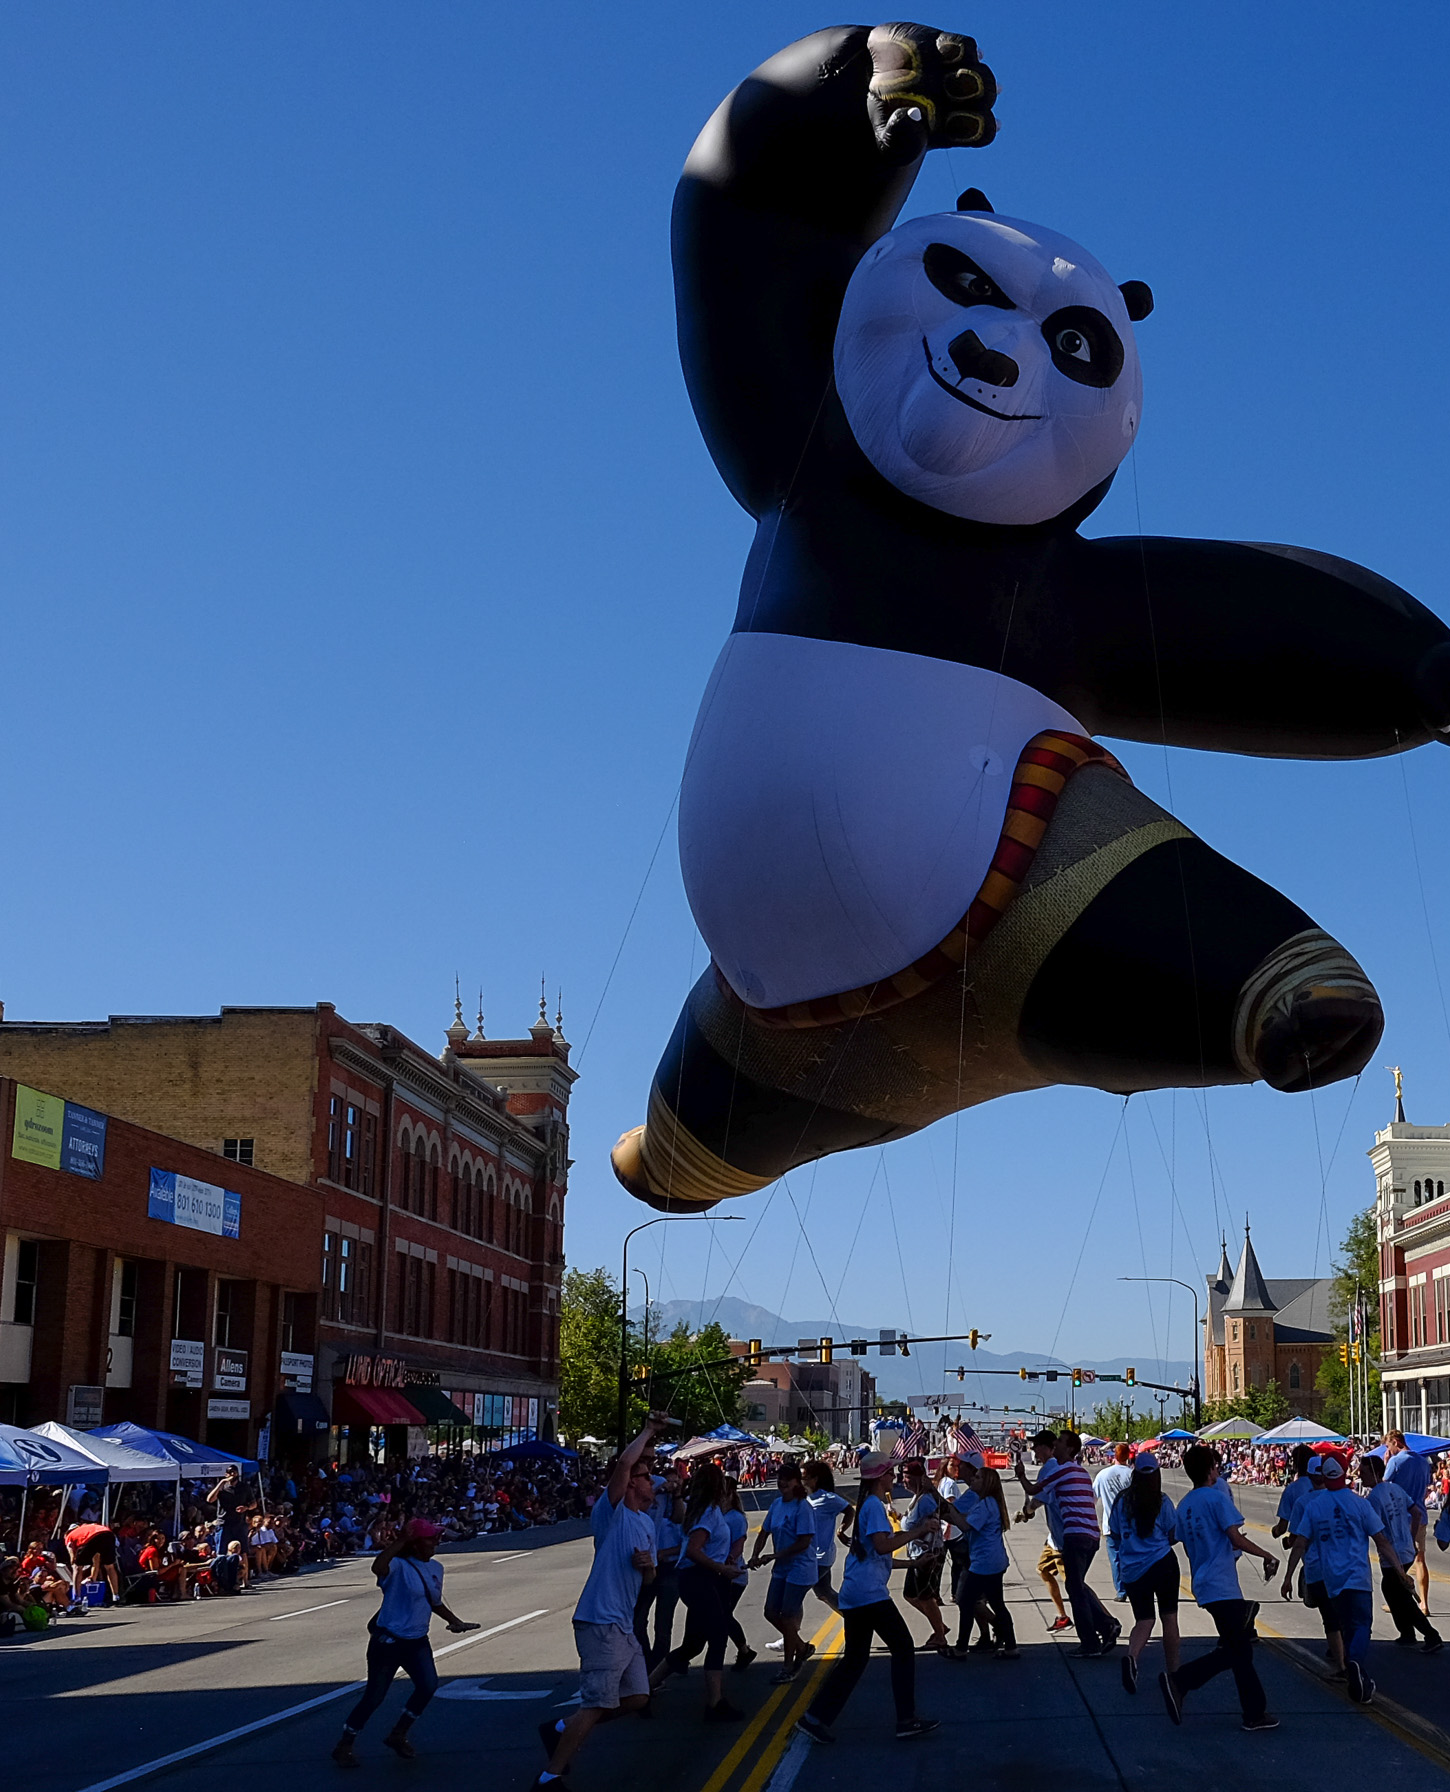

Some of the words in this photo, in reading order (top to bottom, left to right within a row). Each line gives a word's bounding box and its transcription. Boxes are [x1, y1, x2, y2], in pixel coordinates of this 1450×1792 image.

[68, 1136, 99, 1158] ATTORNEYS
[177, 1193, 190, 1211] 801
[191, 1198, 203, 1215] 610
[205, 1201, 221, 1220] 1300
[172, 1344, 186, 1354] VIDEO
[172, 1357, 202, 1369] CONVERSION
[220, 1358, 244, 1374] Allens
[373, 1354, 406, 1388] OPTICAL
[220, 1377, 241, 1388] Camera
